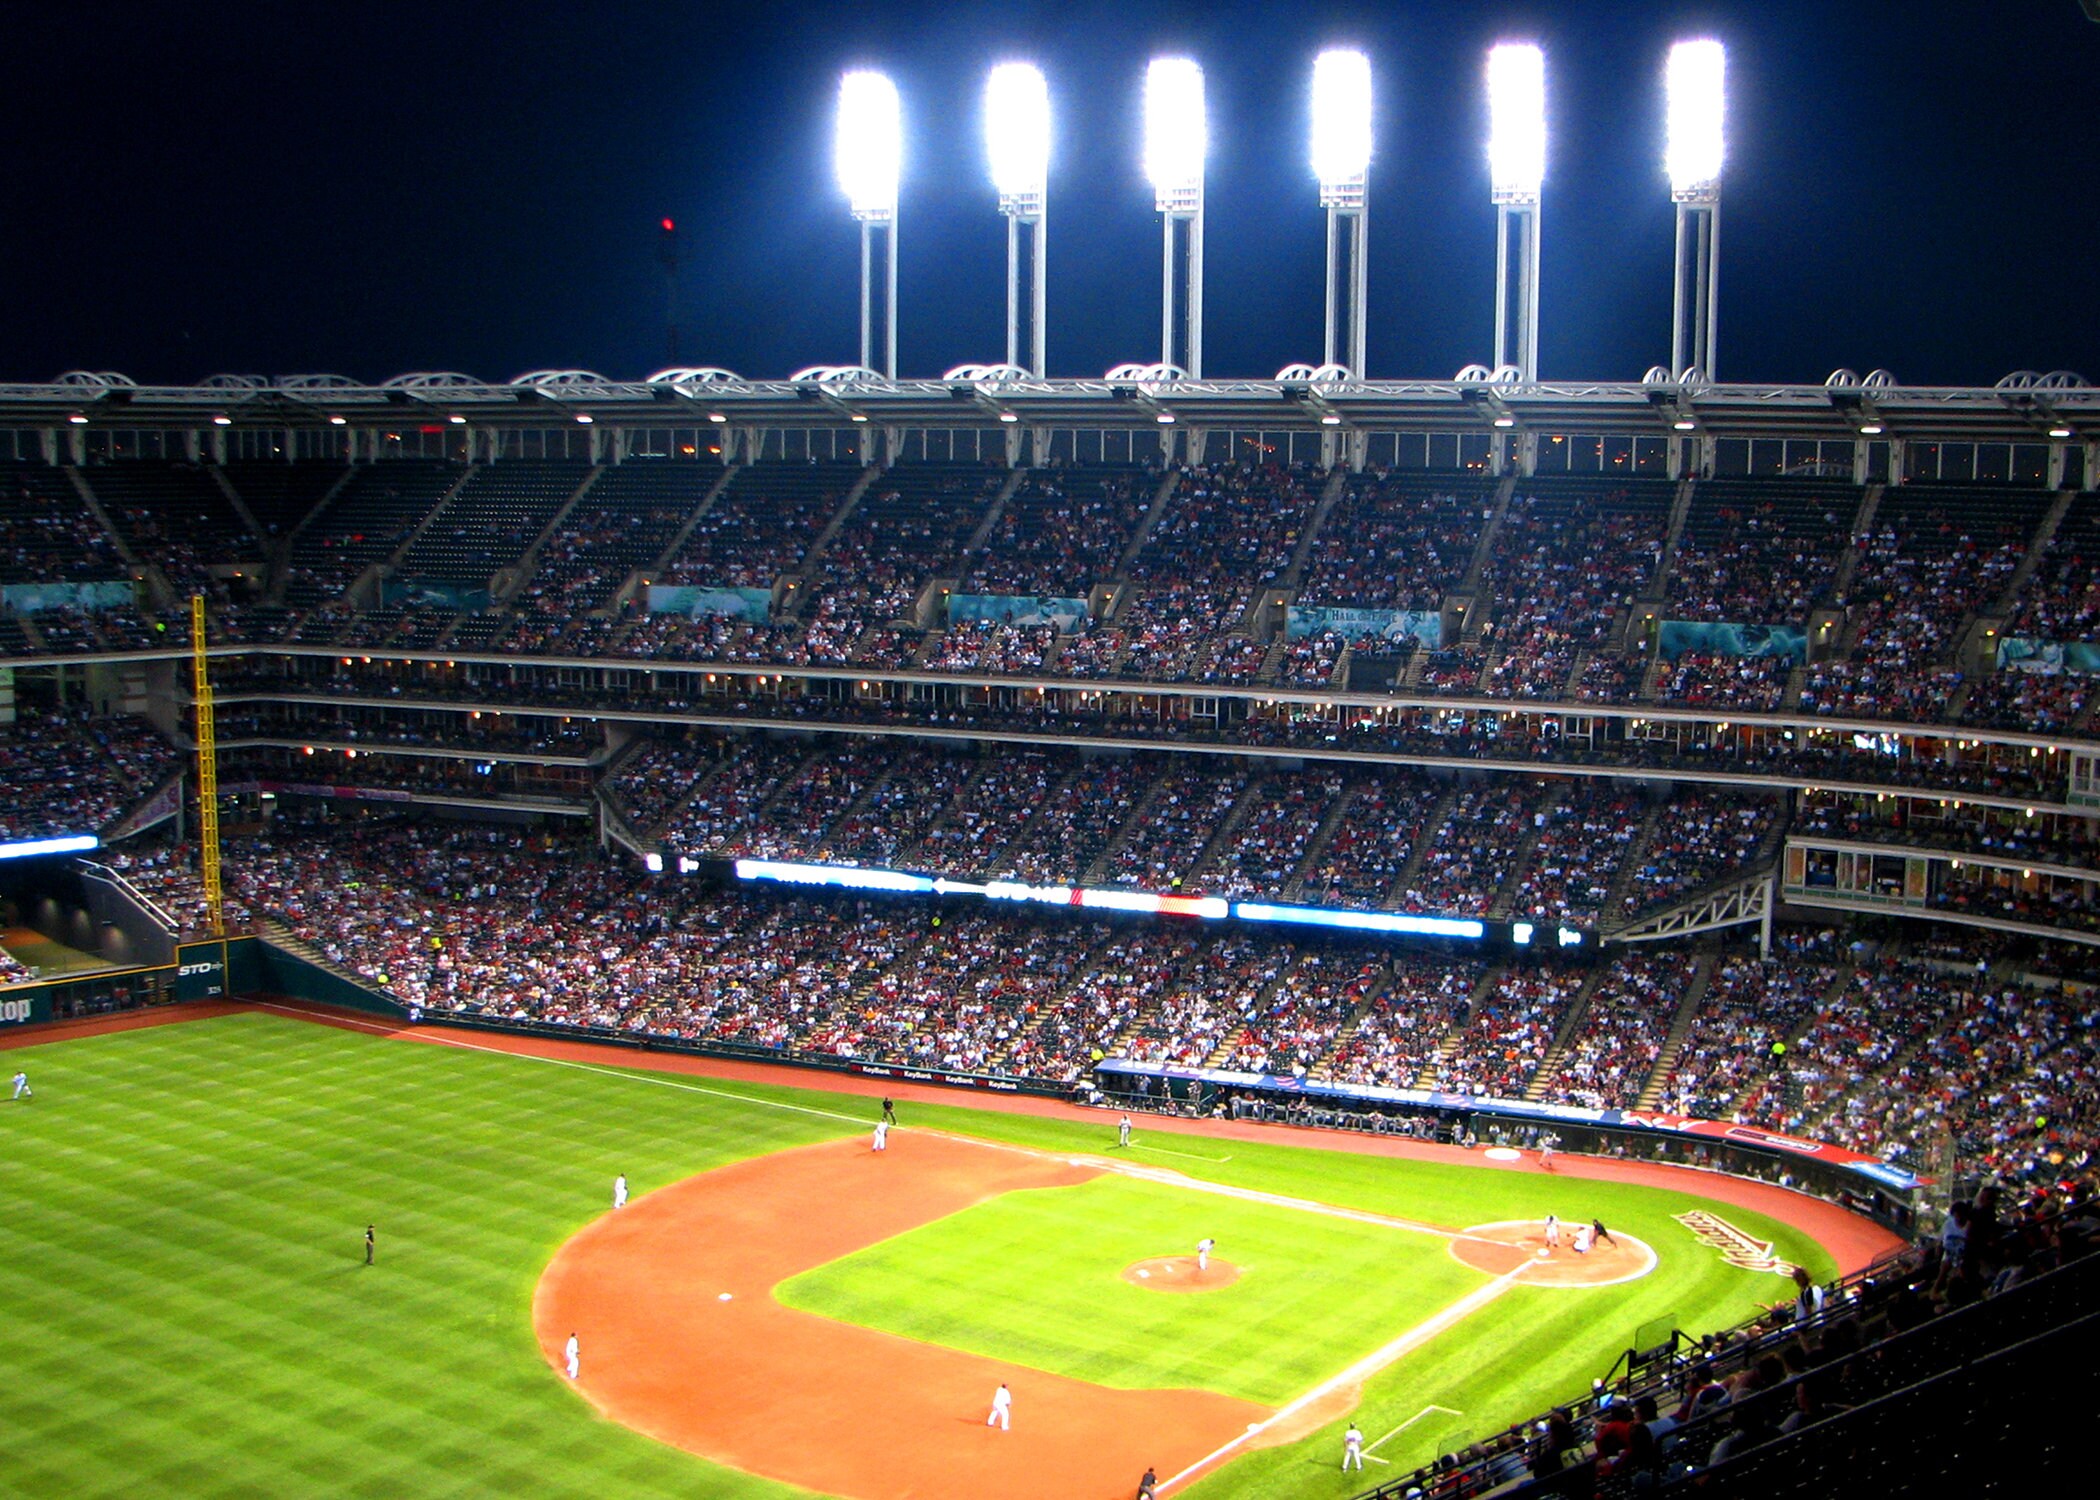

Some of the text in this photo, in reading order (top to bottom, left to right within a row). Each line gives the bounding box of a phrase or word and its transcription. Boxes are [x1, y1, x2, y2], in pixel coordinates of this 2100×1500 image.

[1332, 609, 1356, 620] HALL
[178, 961, 212, 976] STO
[862, 1065, 1017, 1090] KeyBank KeyBank KeyBank KeyBank
